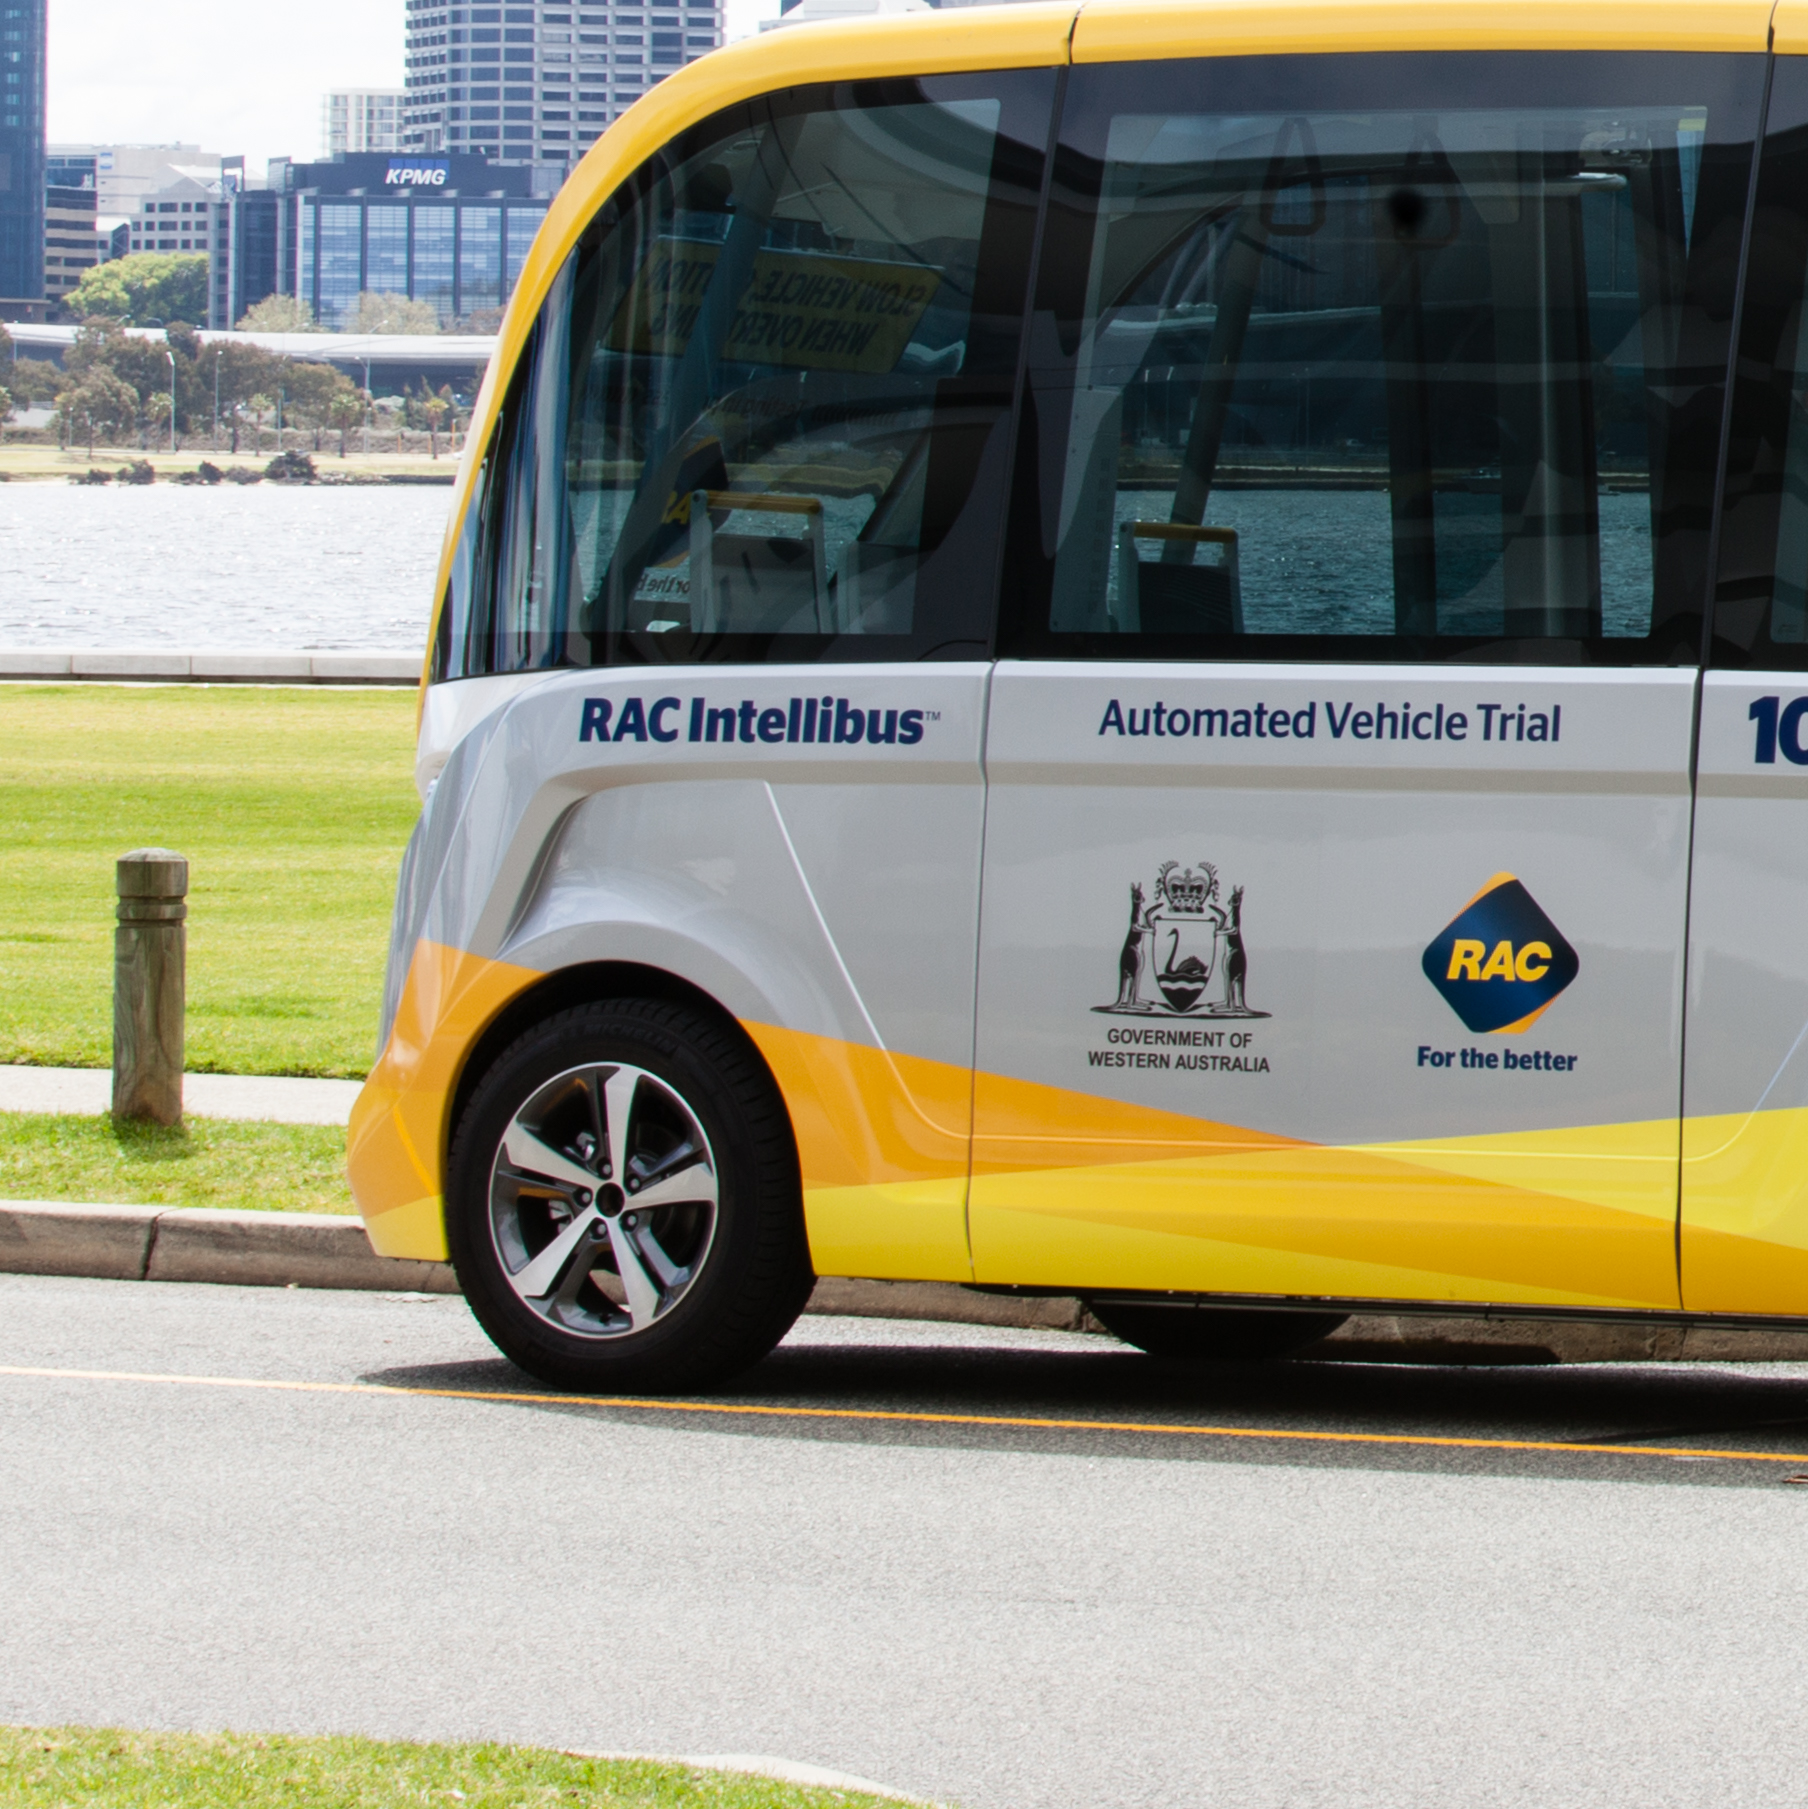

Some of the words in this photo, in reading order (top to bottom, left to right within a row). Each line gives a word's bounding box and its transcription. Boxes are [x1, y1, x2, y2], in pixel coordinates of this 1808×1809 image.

[385, 168, 447, 186] KPMG
[579, 697, 681, 743] RAC
[1098, 699, 1317, 739] Automated
[1325, 702, 1468, 741] Vehicle
[1476, 703, 1562, 742] Trial
[1446, 939, 1553, 982] RAC
[1107, 1028, 1225, 1048] GOVERNMENT
[1230, 1033, 1253, 1048] OF
[1088, 1050, 1171, 1069] WESTERN
[1175, 1054, 1271, 1073] AUSTRALIA
[1416, 1046, 1456, 1068] For
[1460, 1047, 1499, 1069] the
[1503, 1048, 1578, 1071] better
